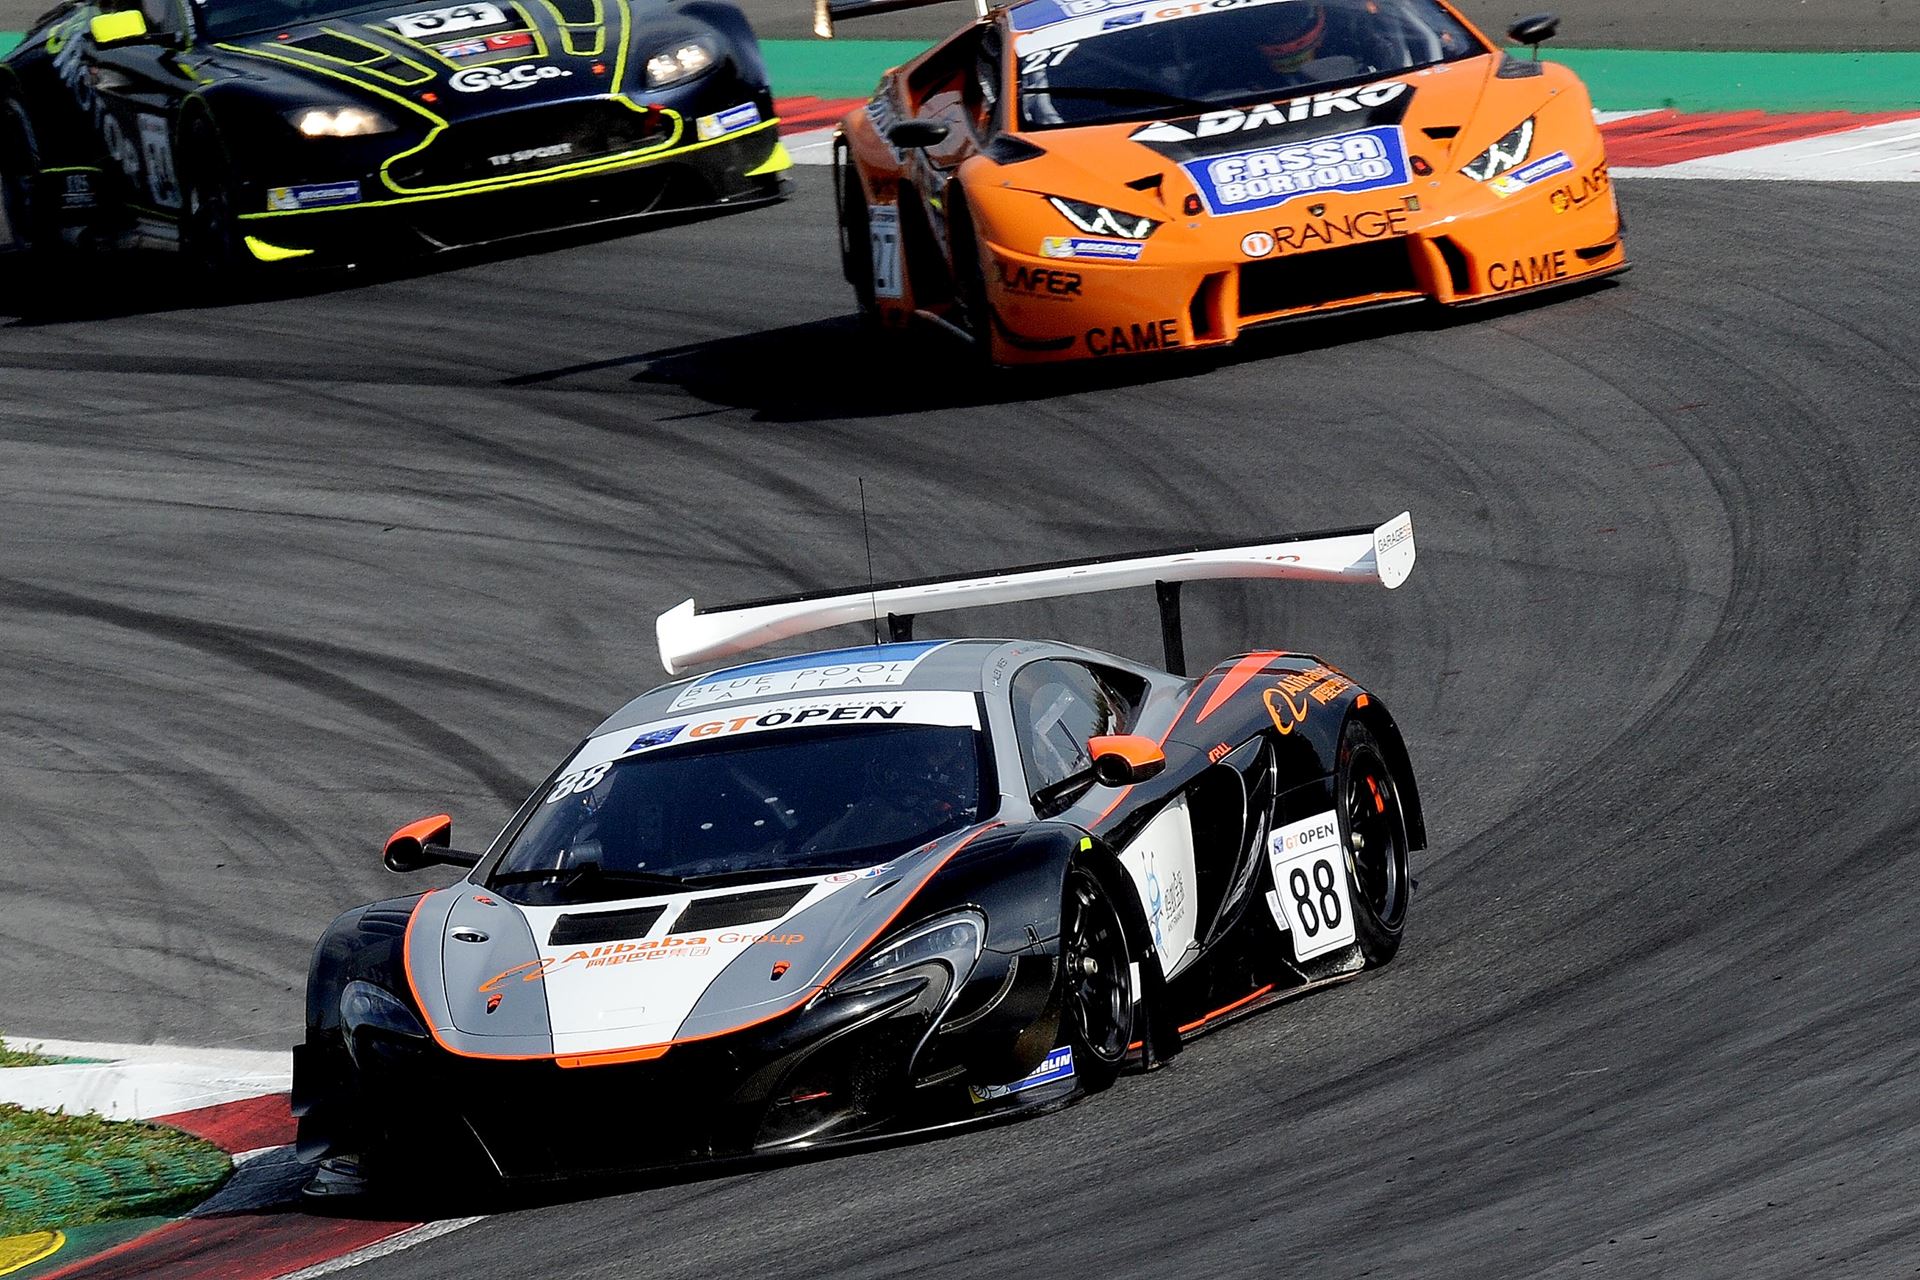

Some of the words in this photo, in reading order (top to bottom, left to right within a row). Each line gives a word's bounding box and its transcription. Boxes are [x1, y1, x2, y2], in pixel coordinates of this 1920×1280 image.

[1021, 43, 1079, 74] 27
[1196, 82, 1407, 138] DAIKO
[1214, 136, 1382, 185] FASSA
[1222, 160, 1388, 201] BORTOLO
[1488, 250, 1567, 291] CAME
[1085, 319, 1180, 355] CAME
[677, 674, 896, 708] CAPITAL
[686, 675, 773, 697] BLUE
[796, 663, 904, 679] POOL
[768, 700, 908, 713] INTERNATIONAL
[546, 762, 613, 804] 88
[1290, 859, 1342, 937] 88
[562, 936, 706, 963] Alibaba
[718, 931, 806, 945] Group
